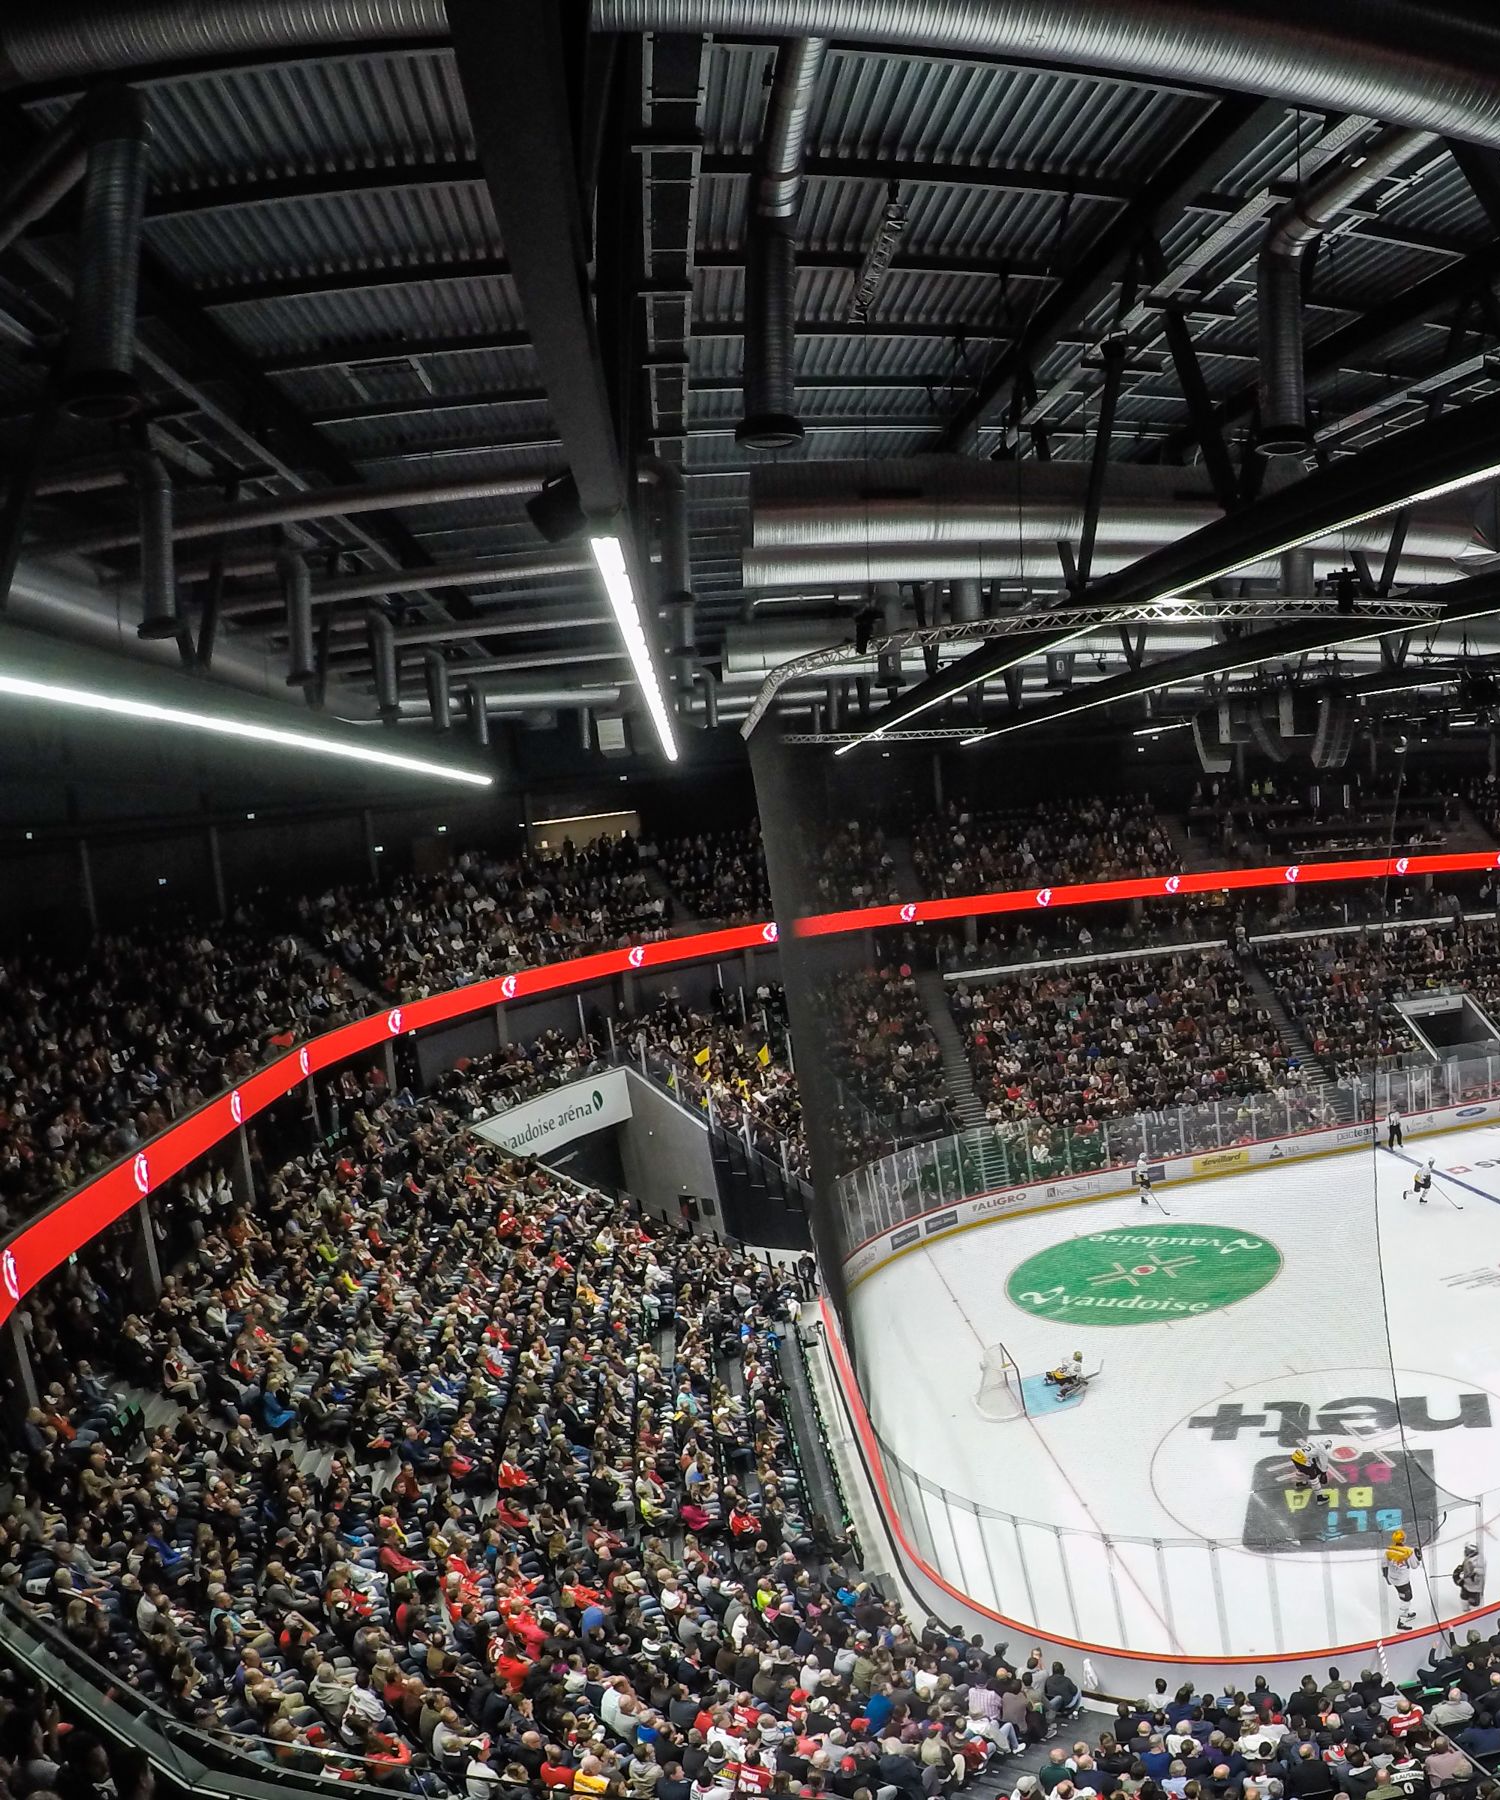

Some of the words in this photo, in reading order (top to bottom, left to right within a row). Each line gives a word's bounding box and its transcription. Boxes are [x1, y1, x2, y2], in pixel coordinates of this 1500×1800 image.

[502, 1118, 555, 1150] vaudoise
[558, 1102, 593, 1126] aréna
[1336, 1126, 1379, 1143] pacteam
[976, 1192, 1027, 1212] ALIGRO
[1089, 1233, 1225, 1248] vaudoise
[1059, 1294, 1210, 1312] vaudoise
[1188, 1393, 1492, 1448] net+
